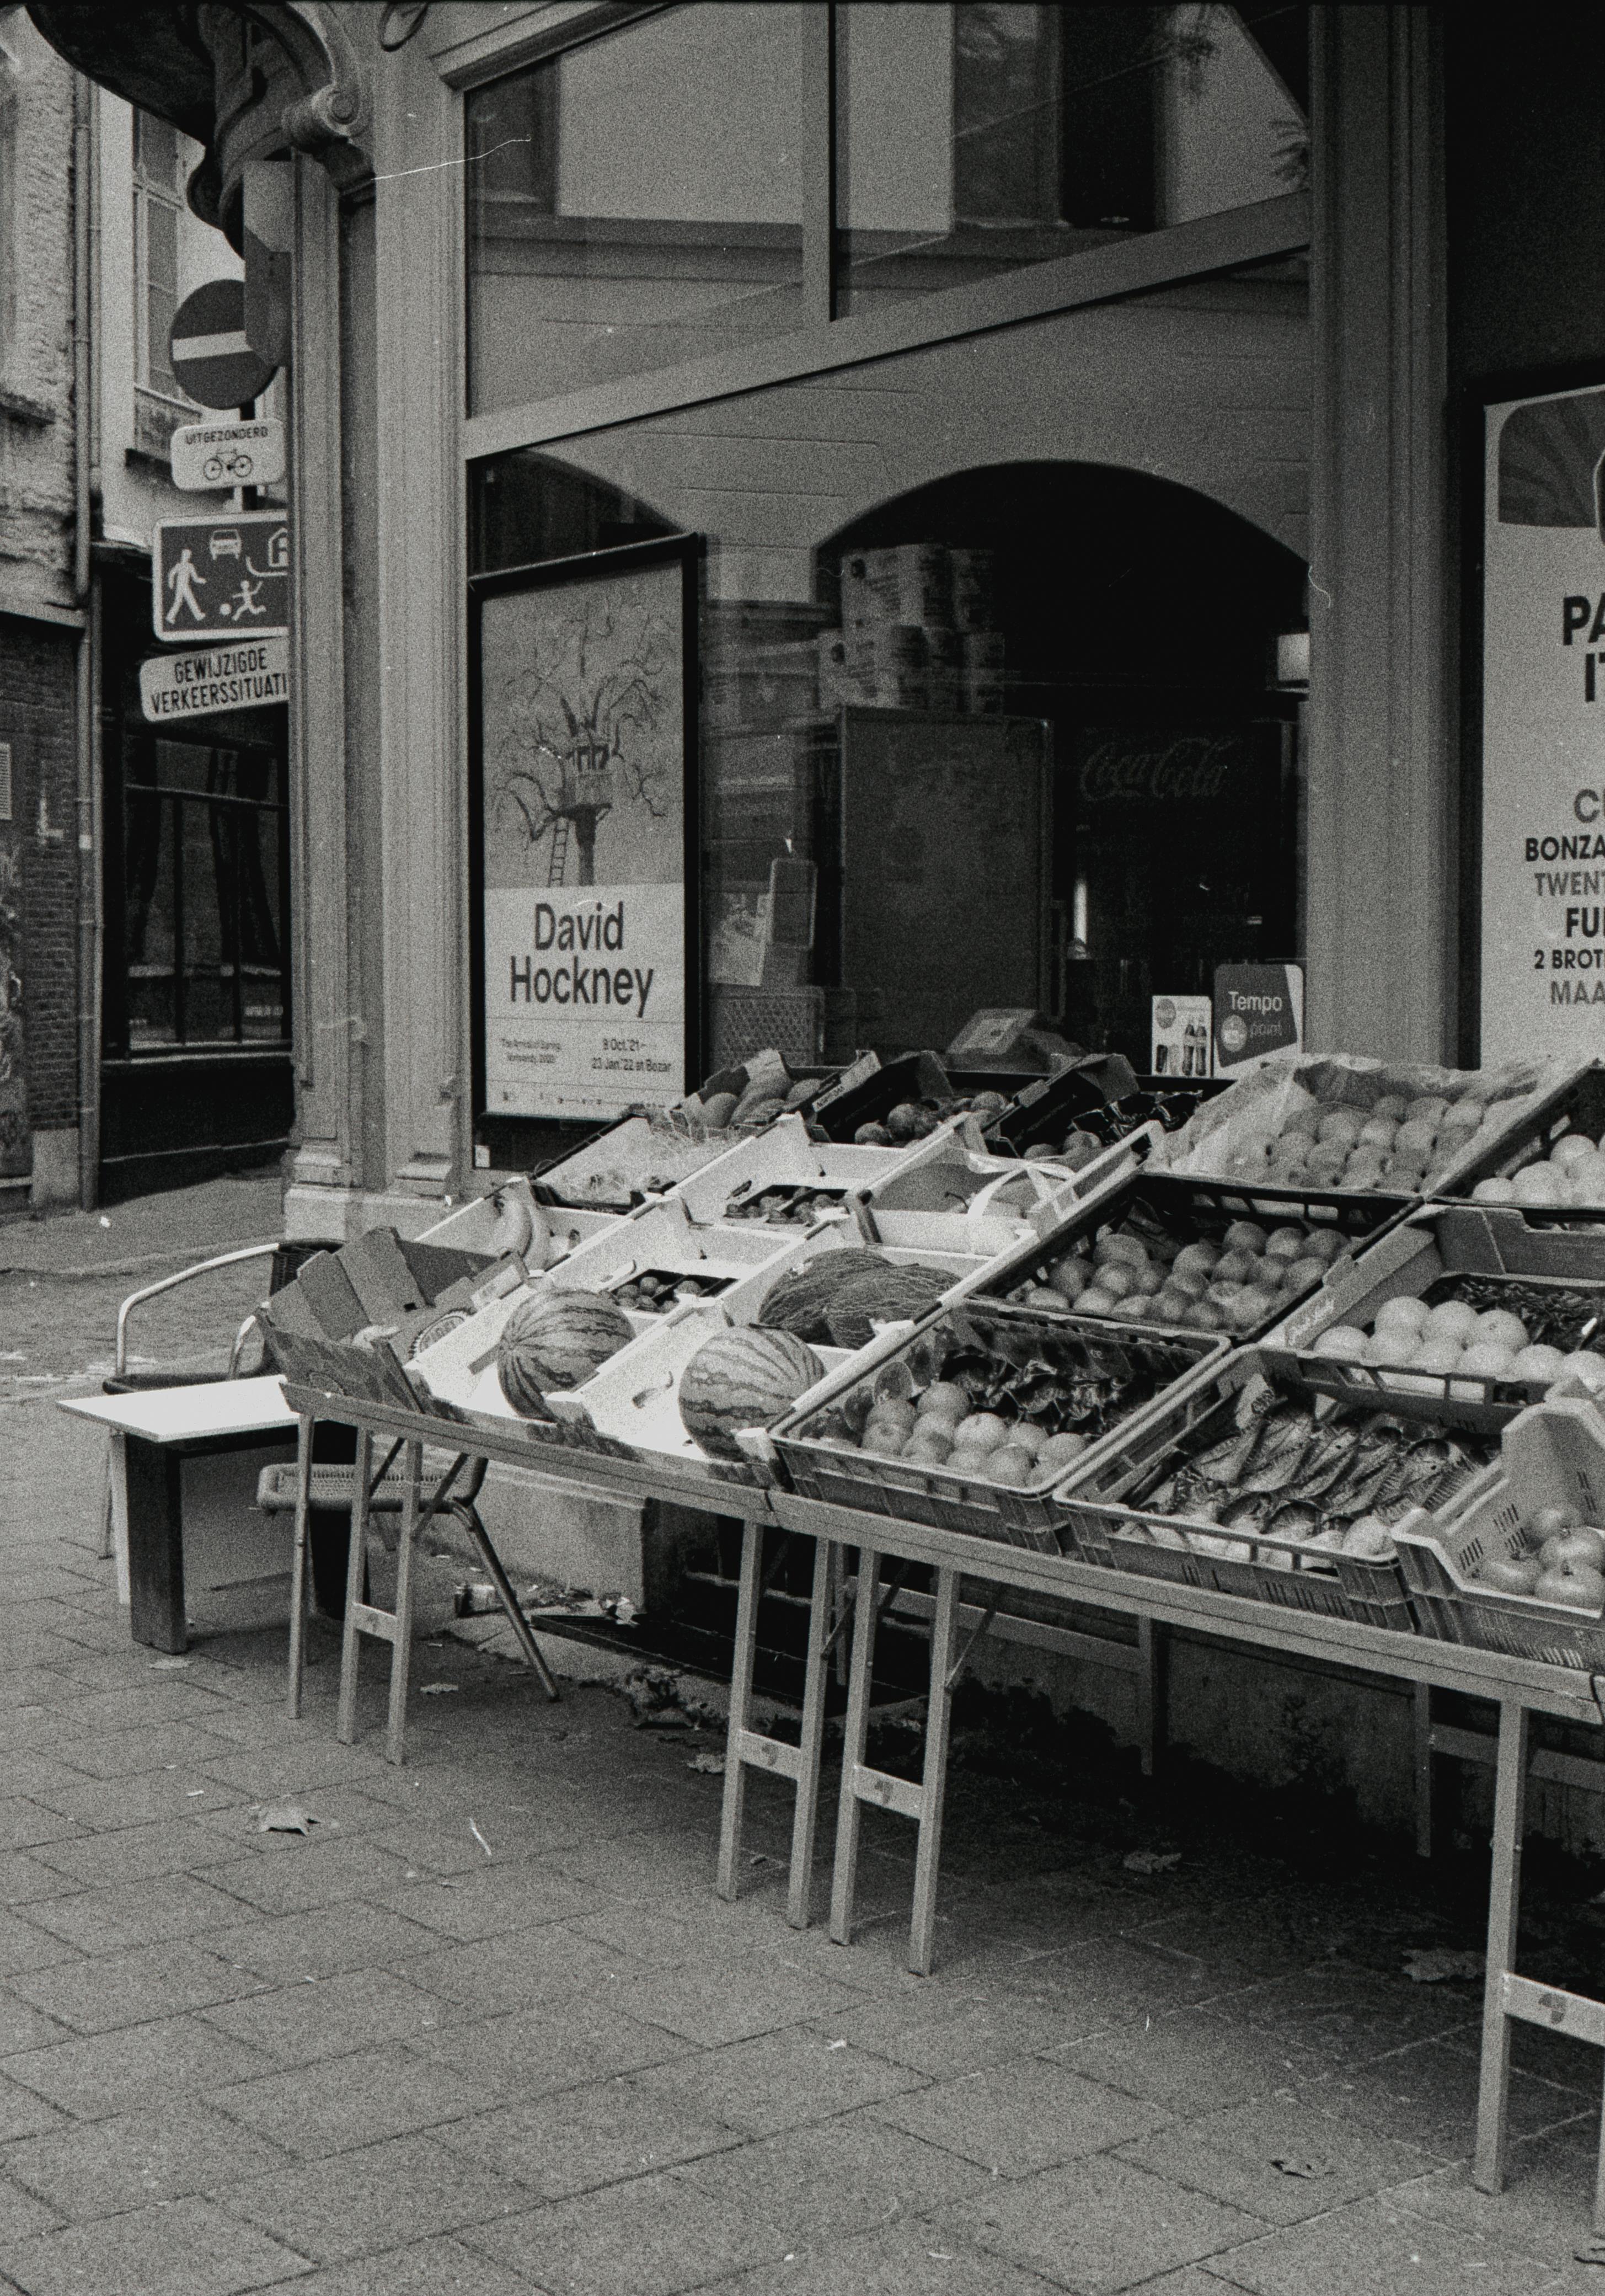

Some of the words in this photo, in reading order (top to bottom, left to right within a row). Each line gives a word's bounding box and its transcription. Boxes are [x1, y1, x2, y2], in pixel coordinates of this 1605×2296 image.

[185, 425, 269, 445] UITGEZONDERD
[174, 647, 268, 684] GEWIJZIGDE
[1585, 652, 1605, 702] I
[1573, 788, 1605, 824] C
[1534, 870, 1605, 897] TWEN
[534, 901, 624, 951] David
[1565, 906, 1605, 938] FU
[1534, 949, 1545, 970] 2
[1552, 948, 1605, 970] BROT
[510, 955, 654, 1018] Hockney
[1550, 980, 1605, 1005] MAA
[1228, 991, 1283, 1016] Tempo
[636, 1060, 644, 1071] at
[645, 1058, 672, 1073] Bozar
